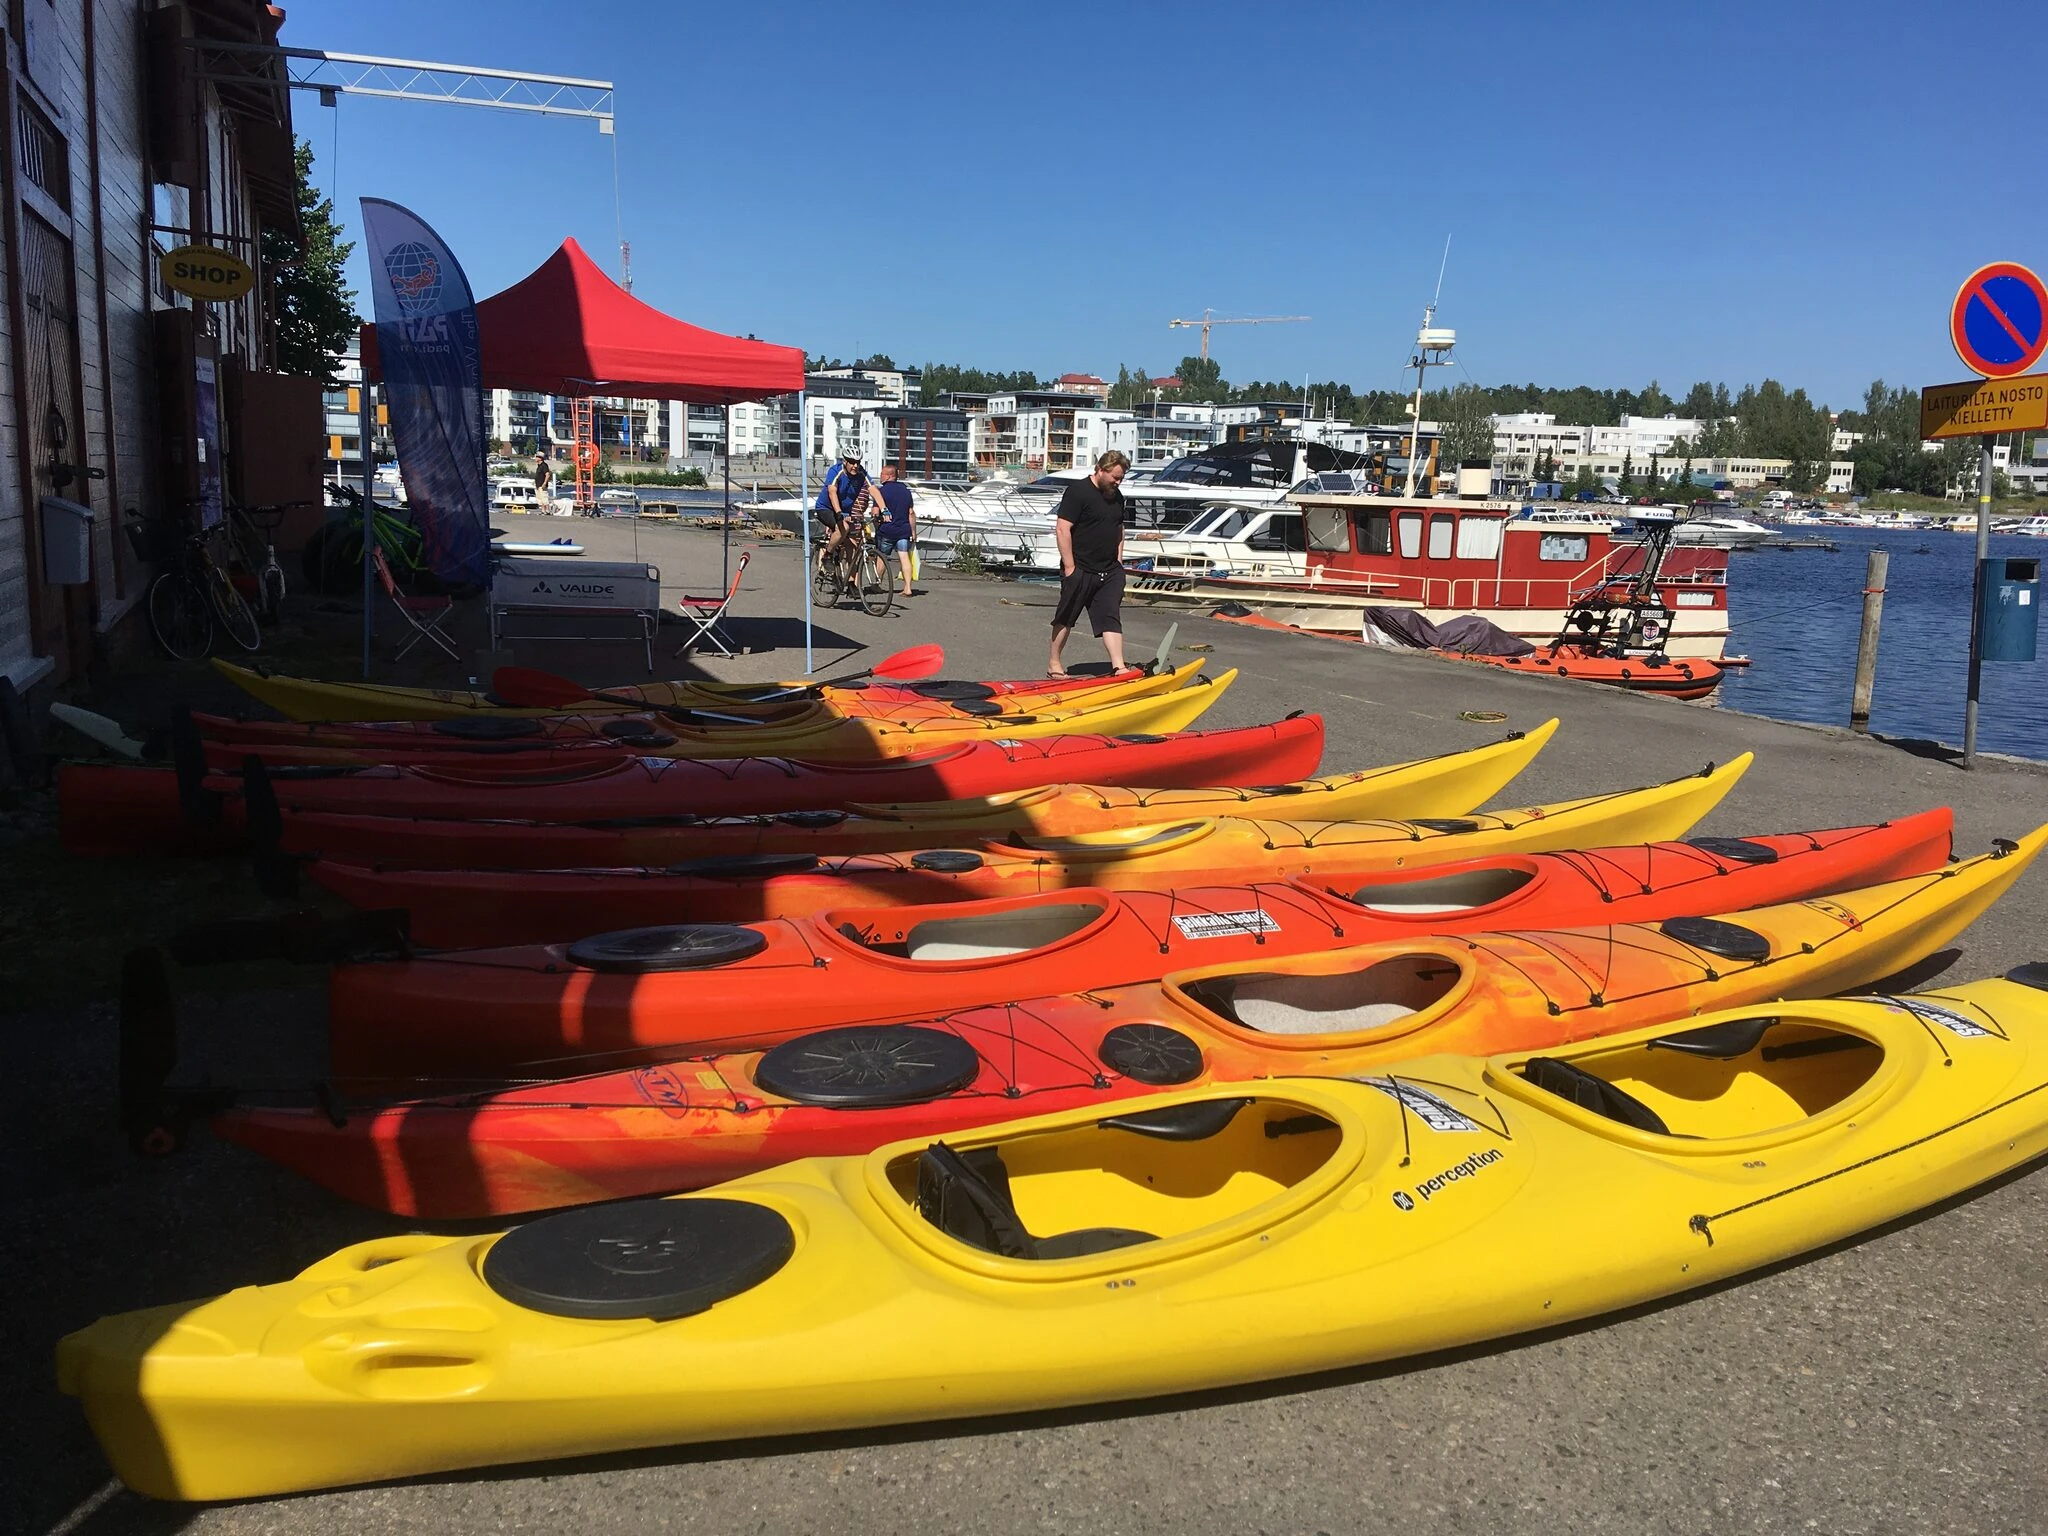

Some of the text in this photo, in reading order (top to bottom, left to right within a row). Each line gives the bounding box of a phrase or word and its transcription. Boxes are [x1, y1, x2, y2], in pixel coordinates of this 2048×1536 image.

[174, 262, 241, 285] SHOP
[1927, 386, 2043, 412] LAITURILTA NOSTO
[1950, 406, 2014, 425] KIELLETTY
[559, 583, 615, 594] VAUDE
[1415, 1148, 1504, 1201] perception
